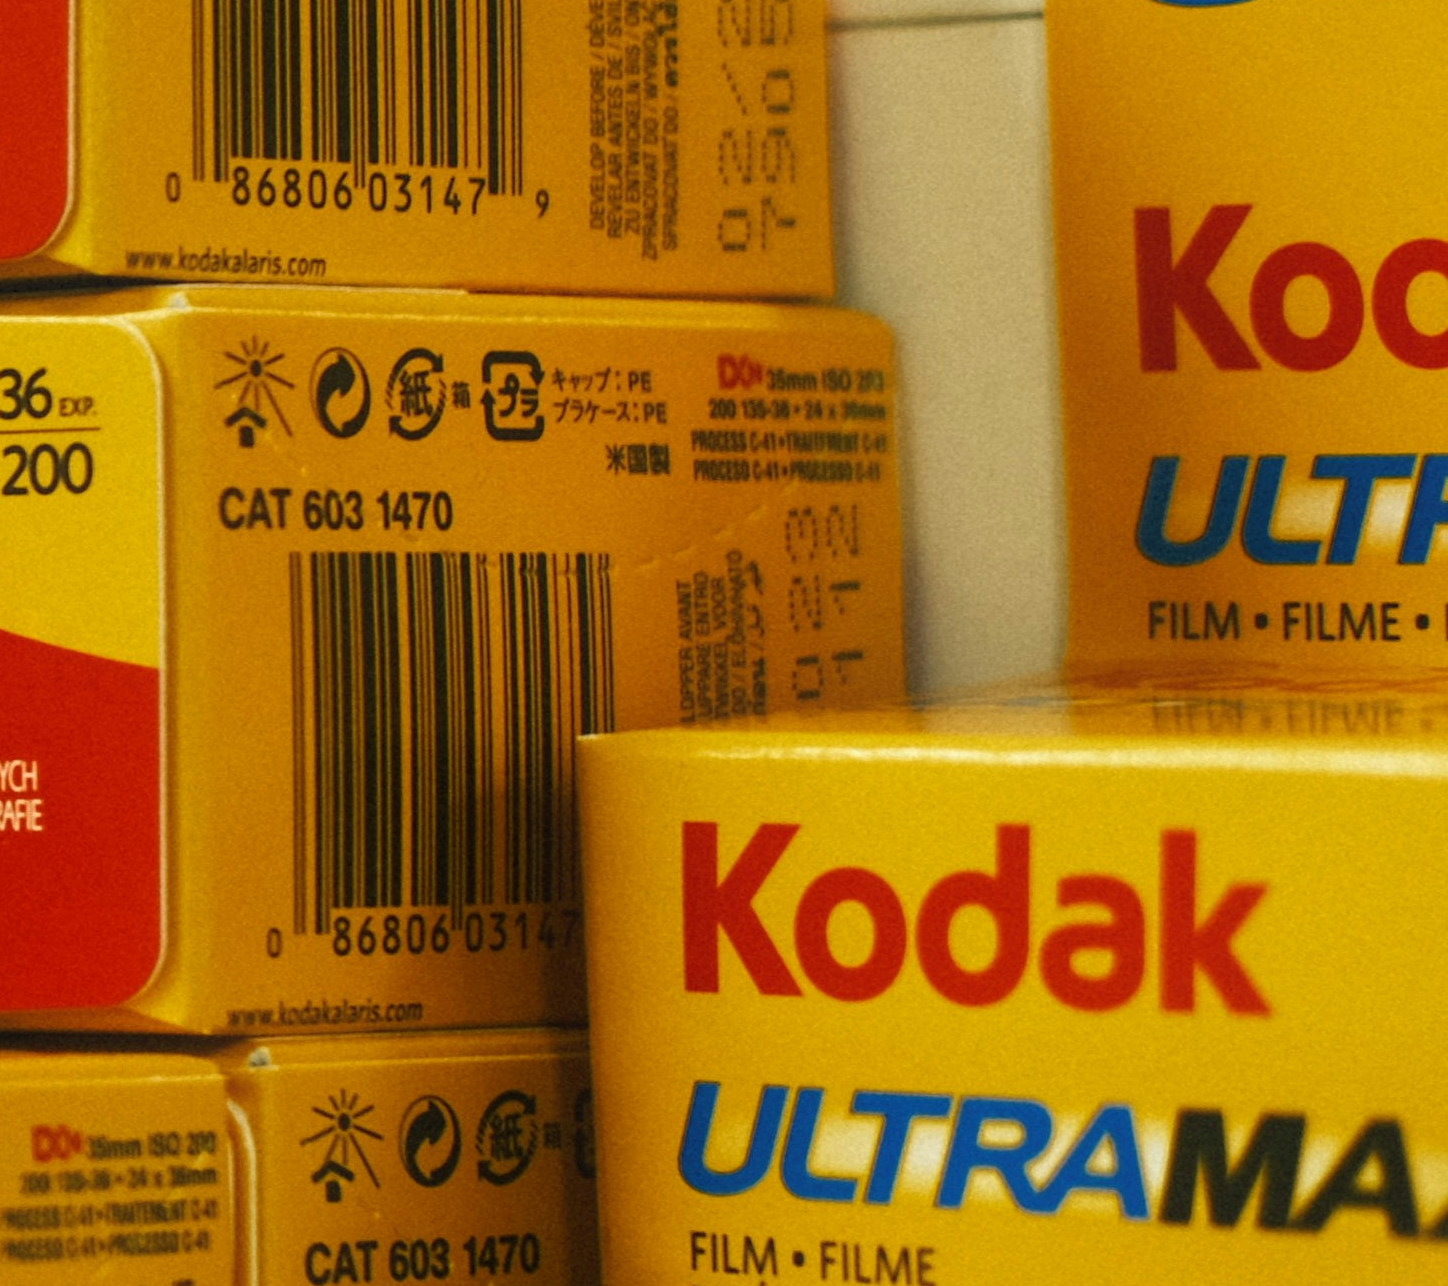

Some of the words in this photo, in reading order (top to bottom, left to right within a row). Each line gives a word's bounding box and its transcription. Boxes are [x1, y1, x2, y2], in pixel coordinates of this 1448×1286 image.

[163, 170, 181, 203] 0
[232, 163, 353, 213] 86806
[367, 169, 486, 220] 03147
[534, 189, 549, 221] 9
[125, 247, 326, 279] www.kodakalaris.com
[58, 397, 96, 418] EXP.
[2, 442, 95, 499] 200
[217, 485, 292, 532] CAT
[302, 488, 364, 532] 603
[376, 488, 453, 532] 1470
[1148, 600, 1242, 642] FILM
[1282, 601, 1402, 642] FILME
[266, 926, 284, 958] 0
[332, 914, 451, 956] 86806
[680, 821, 1273, 1017] Kodak
[678, 1081, 1448, 1245] ULTRAMA
[389, 1235, 451, 1284] 603
[464, 1230, 541, 1279] 1470
[690, 1230, 778, 1276] FILM
